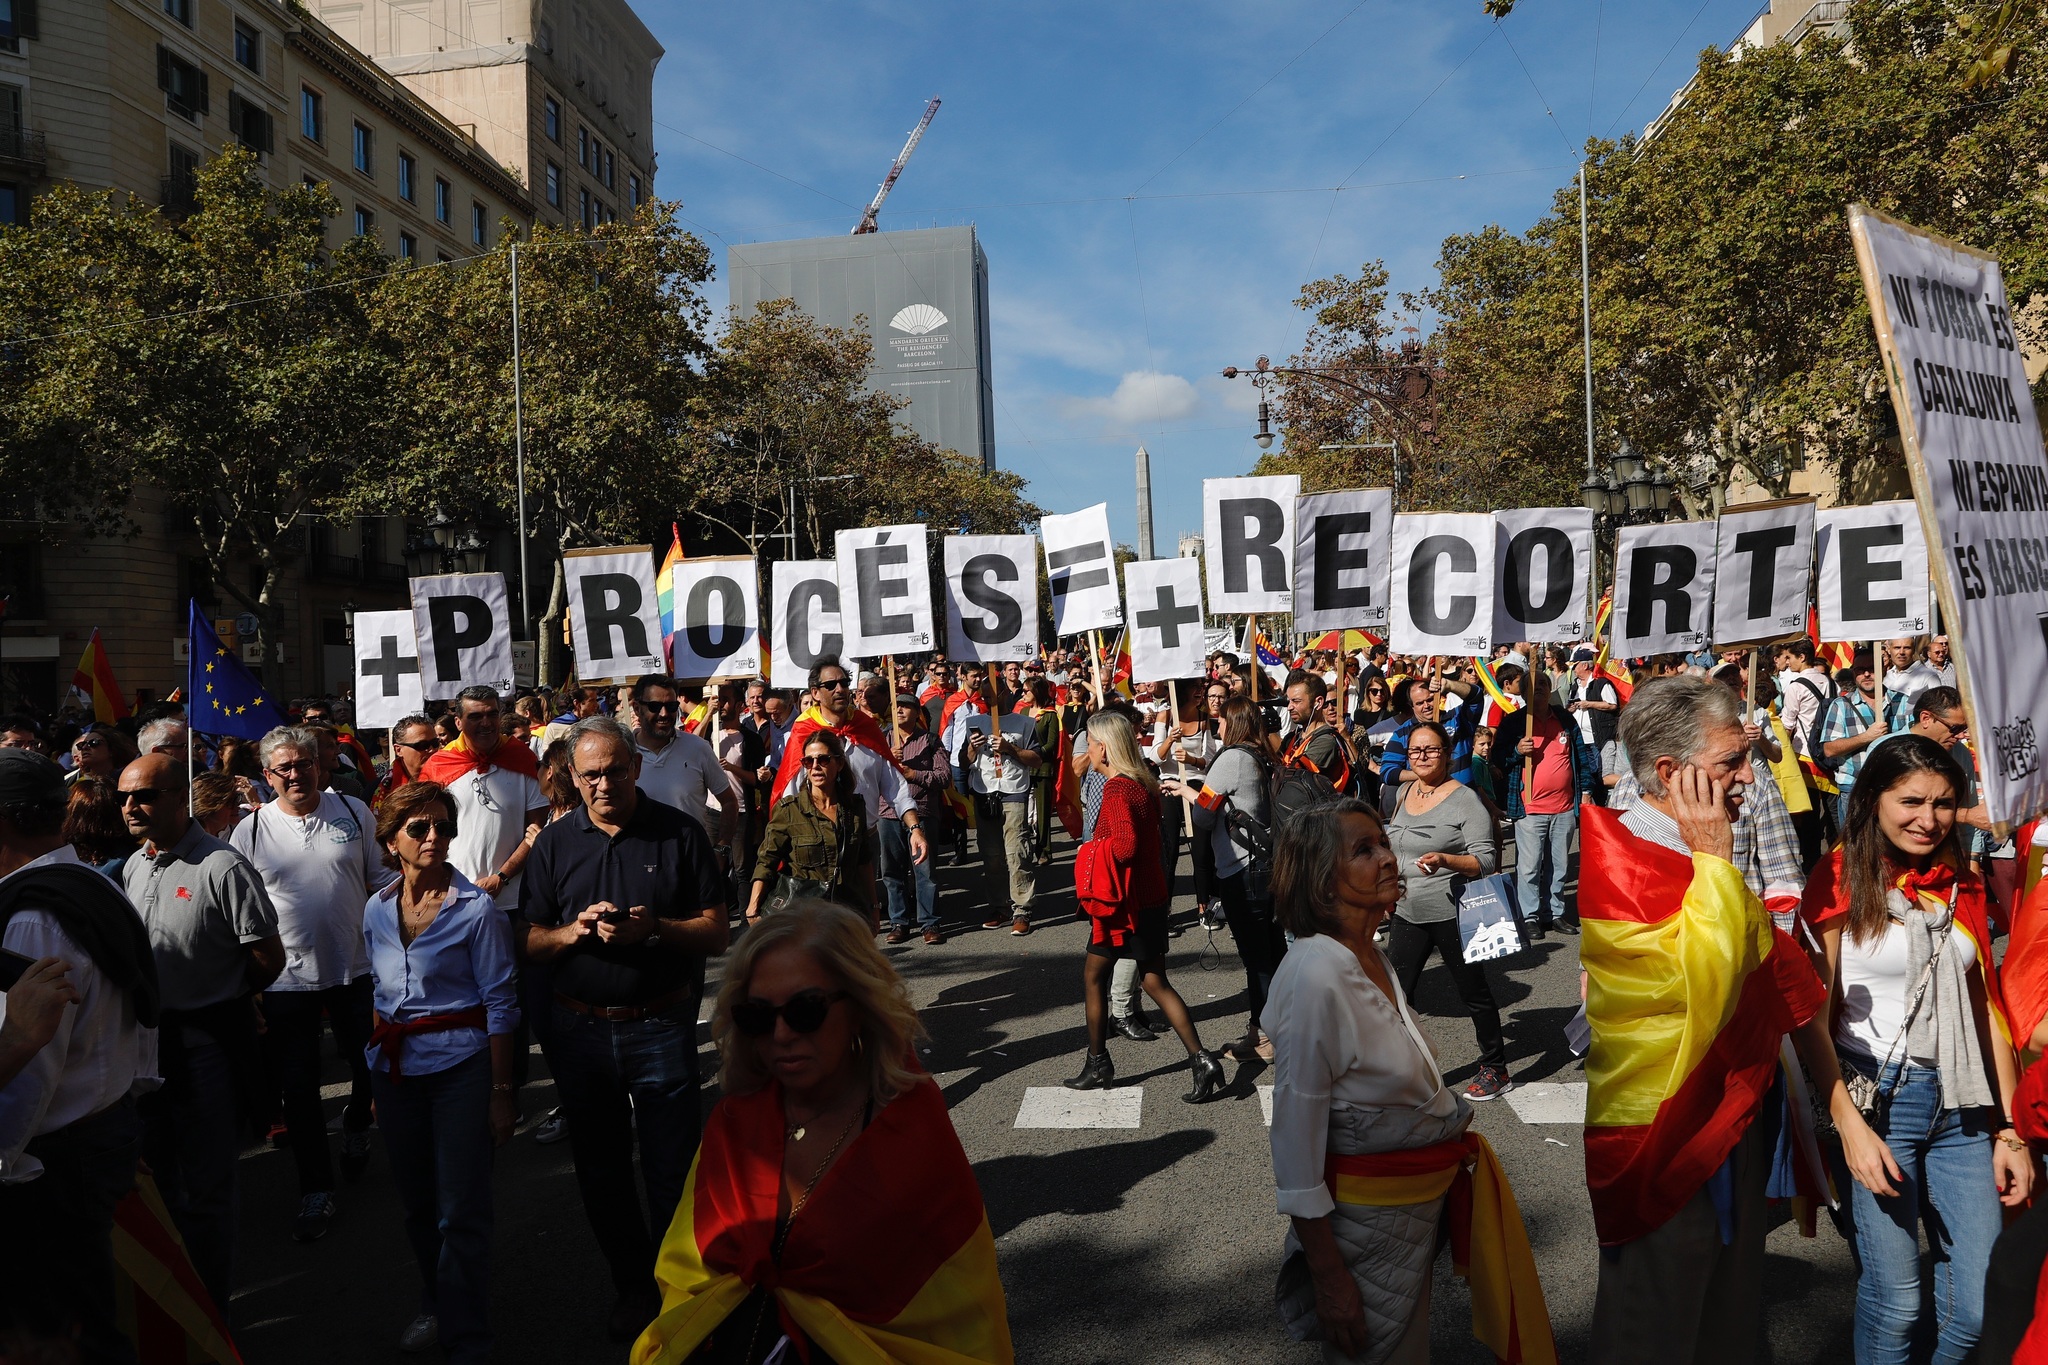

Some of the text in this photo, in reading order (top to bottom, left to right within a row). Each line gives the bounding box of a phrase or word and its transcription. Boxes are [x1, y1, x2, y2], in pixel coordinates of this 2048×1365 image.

[1889, 274, 2014, 351] NI TORRA ÉS
[1914, 357, 2021, 424] CATALUNYA
[1948, 459, 2048, 512] NI ESPANYA
[1954, 533, 2048, 601] ÉS ABASC
[2007, 744, 2039, 781] CERO
